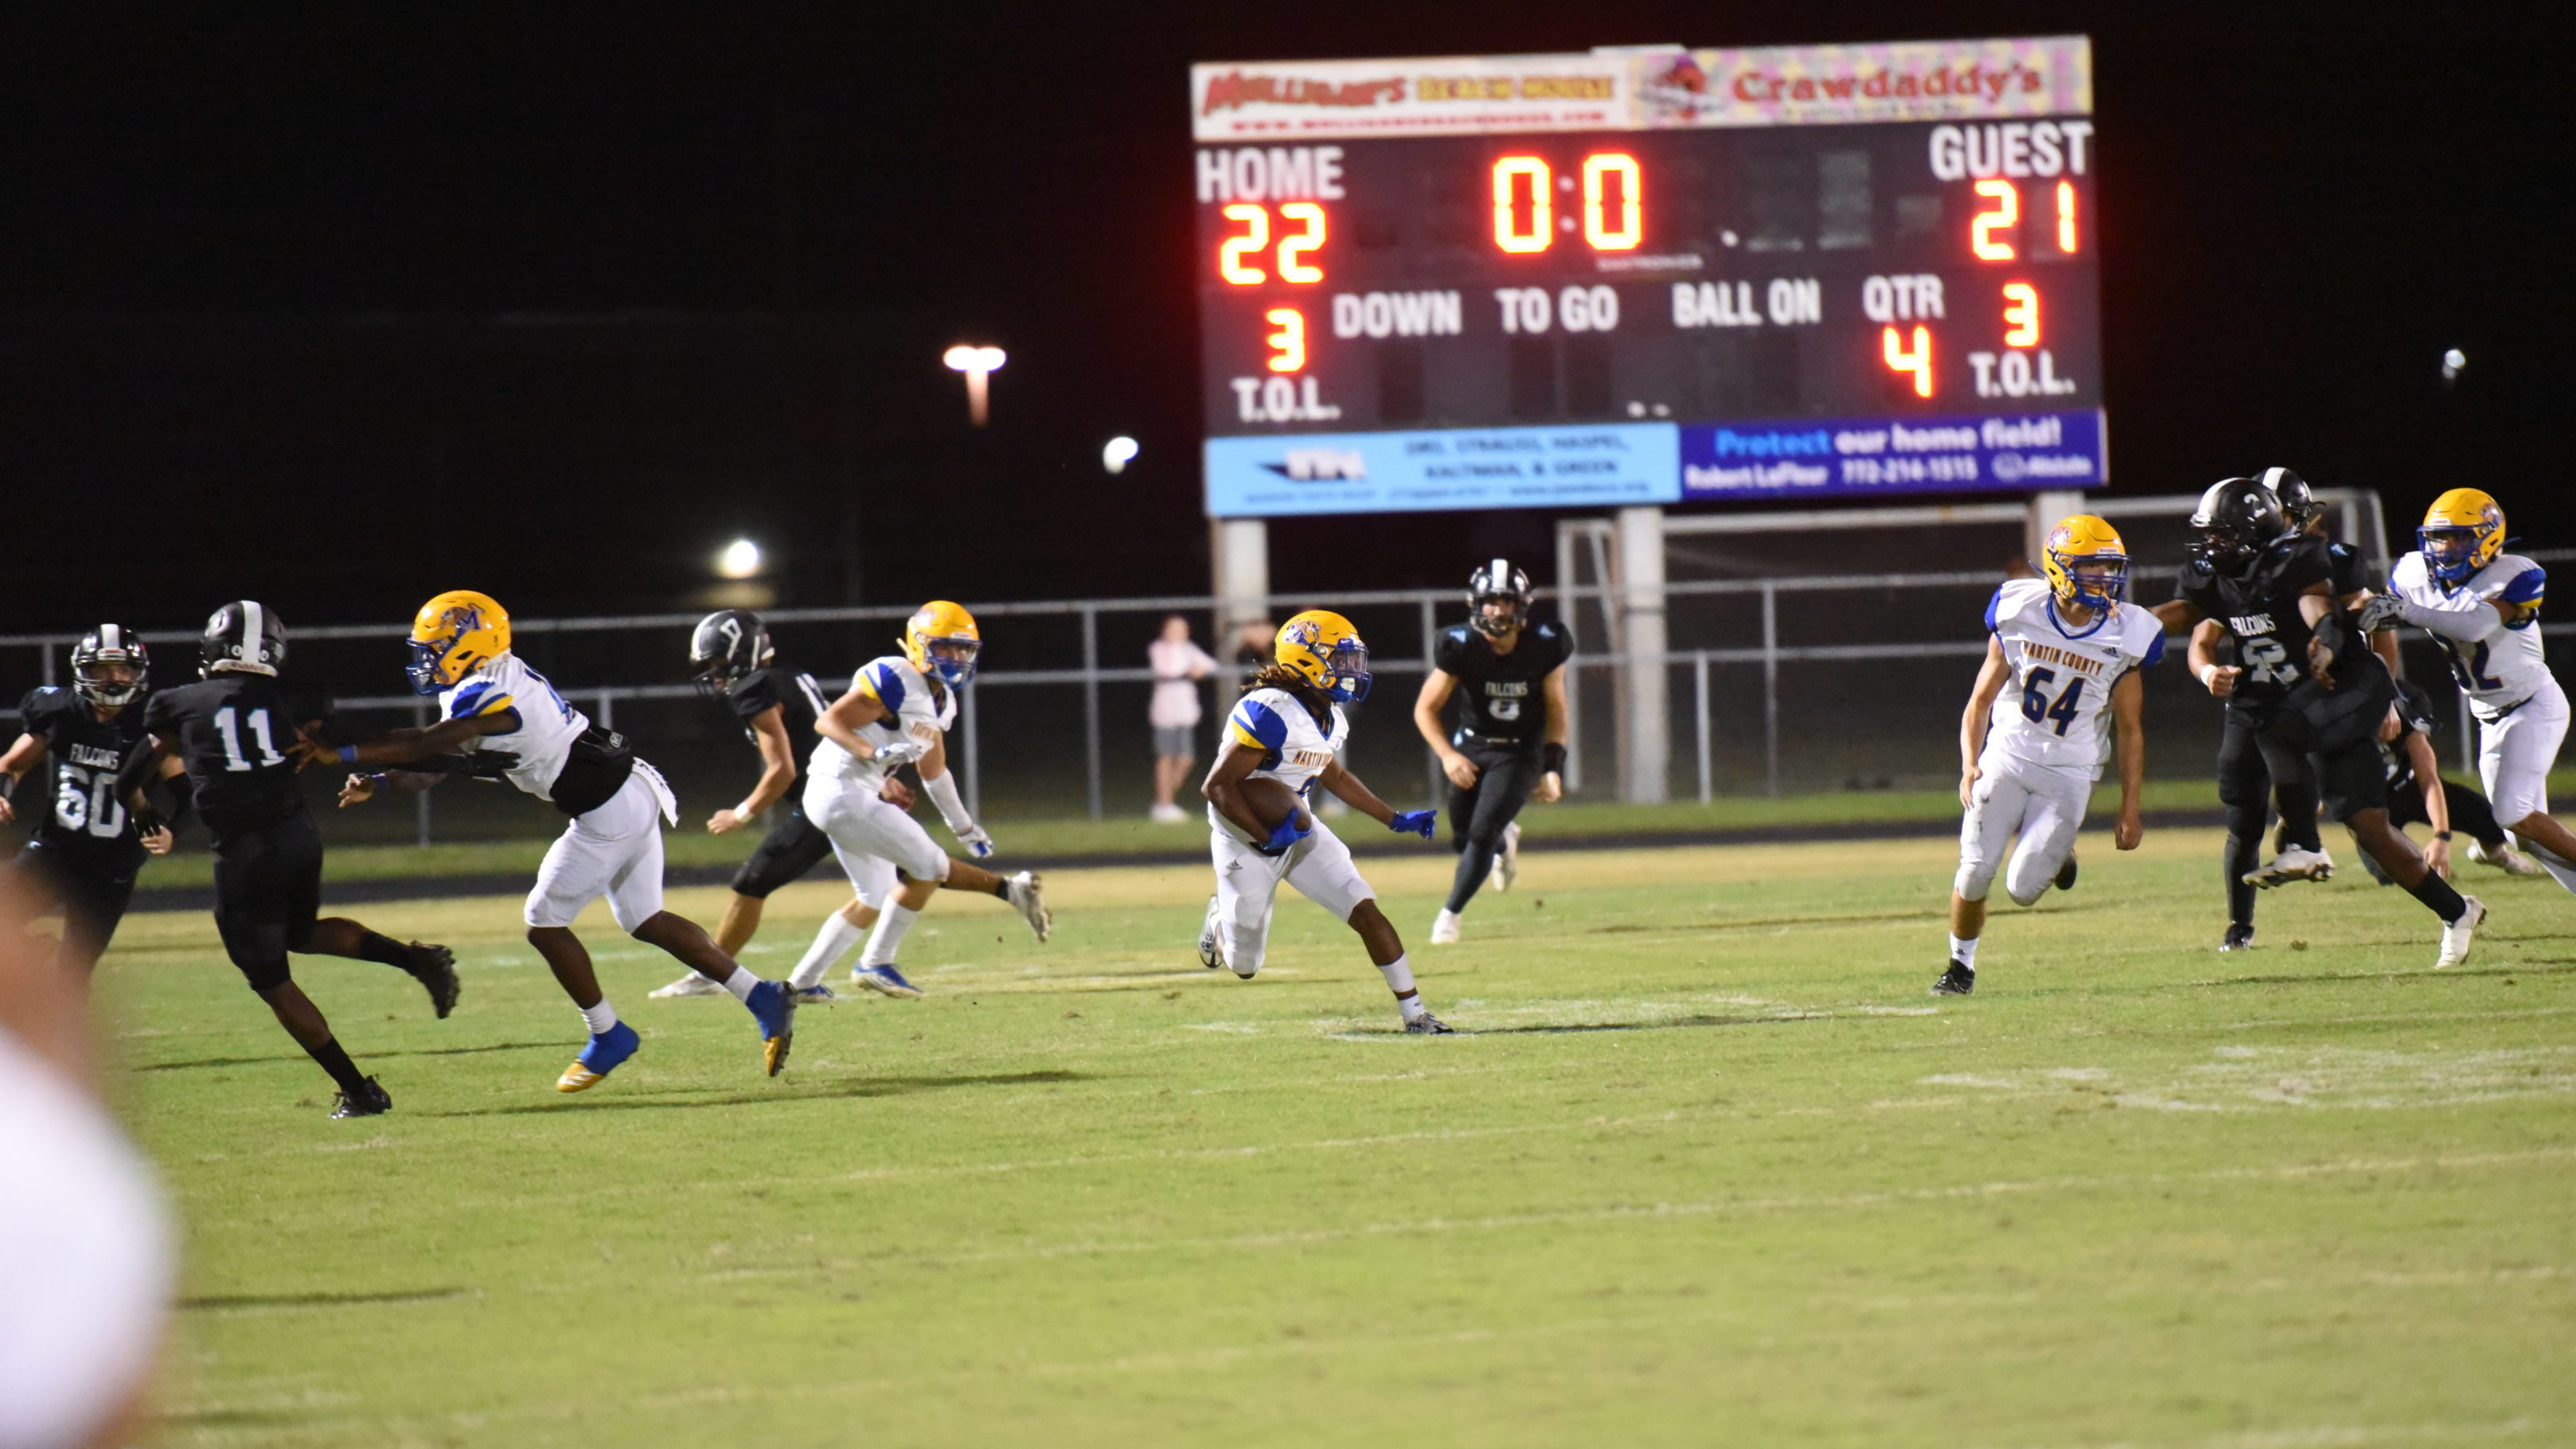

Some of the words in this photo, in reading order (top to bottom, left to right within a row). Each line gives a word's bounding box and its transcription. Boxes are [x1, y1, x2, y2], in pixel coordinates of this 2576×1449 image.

[1732, 64, 2041, 104] Crawdaddy's
[1196, 146, 1345, 203] HOME
[1929, 122, 2094, 181] GUEST
[1220, 202, 1326, 285] 22
[1970, 179, 2077, 260] 21
[1332, 290, 1462, 339] DOWN
[1494, 287, 1551, 334] TO
[1559, 285, 1619, 333] GO
[1672, 280, 1762, 327] BALL
[1768, 278, 1822, 326] ON
[1862, 274, 1945, 322] QTR
[2002, 283, 2039, 348] 3
[1266, 308, 1306, 373] 3
[1882, 325, 1933, 398] 4
[1231, 375, 1342, 422] T.O.L.
[1968, 350, 2076, 398] T.O.L.
[1714, 428, 1830, 458] Protect
[1833, 431, 1888, 455] our
[1890, 420, 1979, 454] home
[2229, 612, 2277, 637] FALCONS
[2023, 641, 2063, 666] MARTIN
[2060, 650, 2104, 677] COUNTY
[2022, 666, 2086, 737] 64
[69, 743, 119, 770] FALCONS
[213, 705, 287, 771] 11
[56, 764, 126, 838] 60
